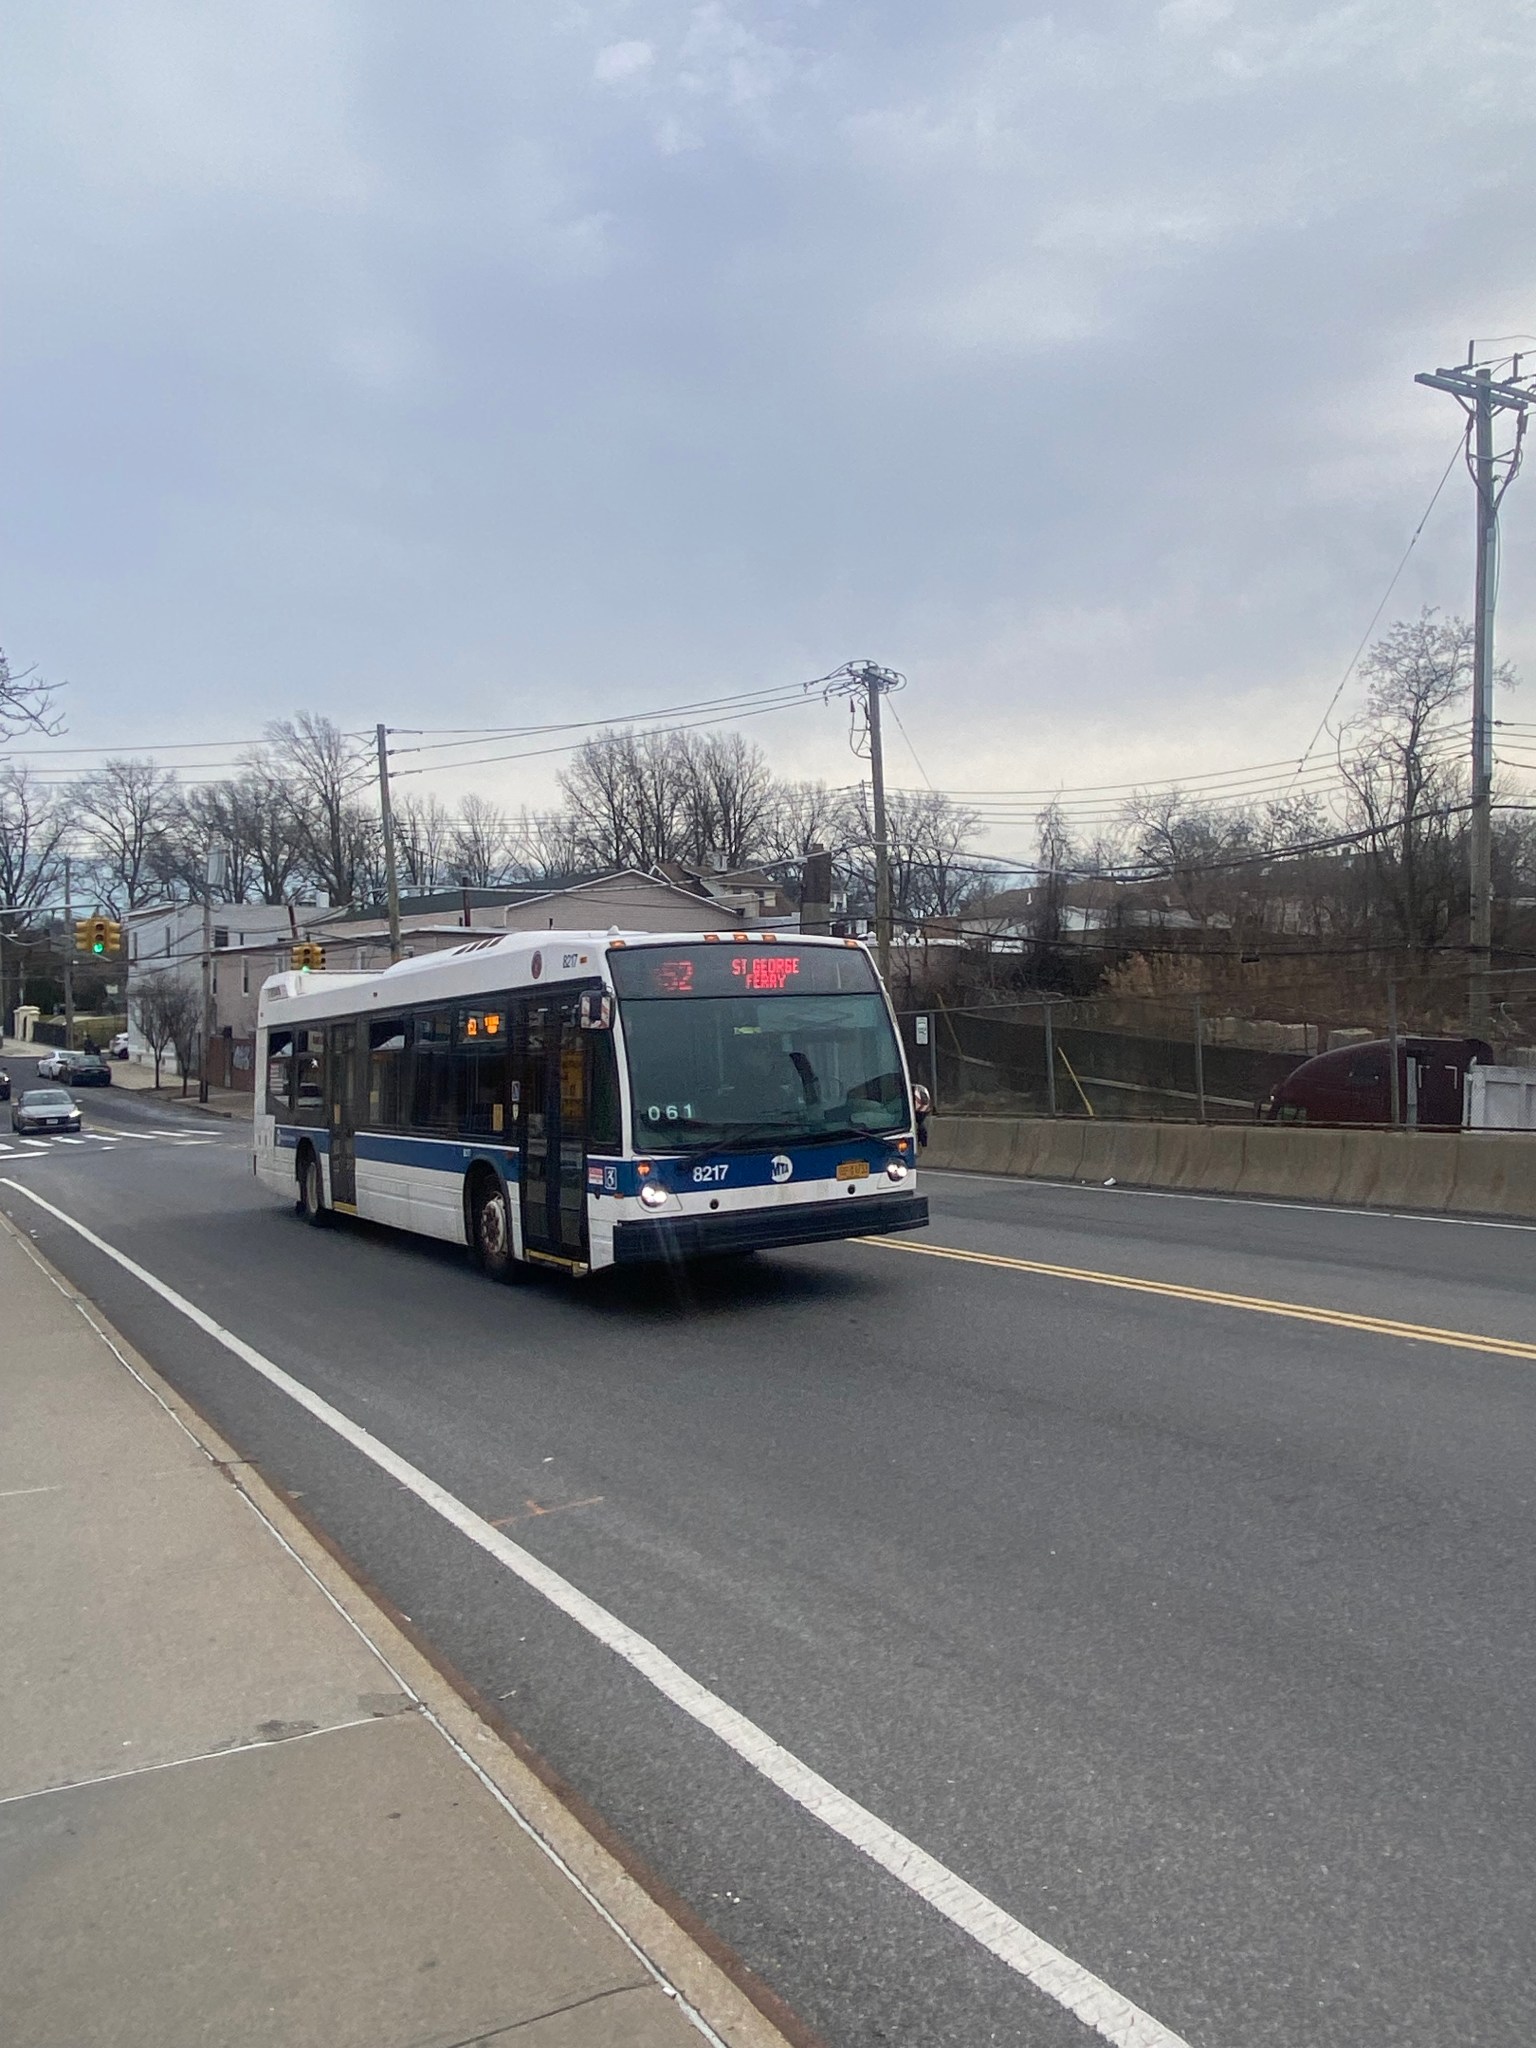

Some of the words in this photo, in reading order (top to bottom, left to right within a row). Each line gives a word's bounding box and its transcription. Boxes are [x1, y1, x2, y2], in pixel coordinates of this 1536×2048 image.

[562, 953, 578, 968] 8217
[731, 958, 748, 975] ST
[752, 957, 800, 974] GEORGE
[745, 974, 787, 990] FERRY
[693, 1164, 729, 1182] 8217
